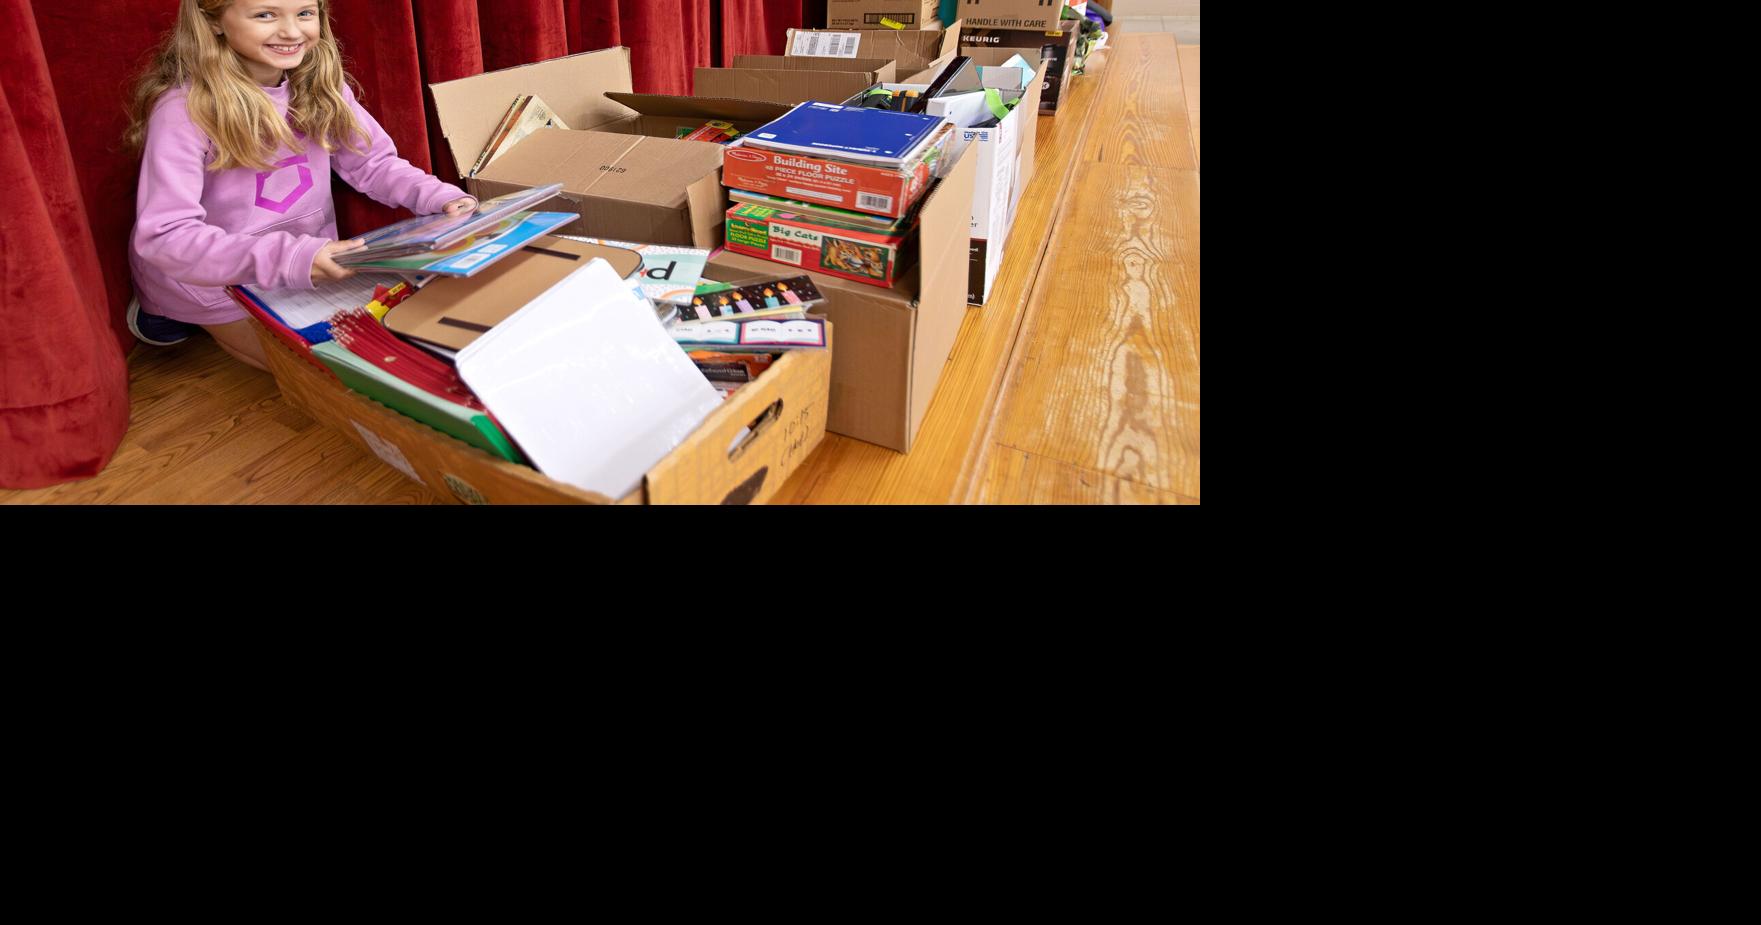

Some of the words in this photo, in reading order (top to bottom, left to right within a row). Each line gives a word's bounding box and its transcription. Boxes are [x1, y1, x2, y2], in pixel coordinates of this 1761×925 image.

[966, 18, 998, 26] HANDLE
[999, 19, 1023, 27] WITH
[1024, 20, 1047, 28] CARE
[962, 35, 1000, 43] KEURIG
[773, 155, 822, 173] Building
[824, 163, 848, 176] Site
[775, 166, 797, 175] PIECE
[798, 170, 824, 180] FLOOR
[824, 175, 856, 185] PUZZLE
[773, 225, 791, 237] Big
[794, 230, 818, 241] Cats
[646, 260, 677, 281] d
